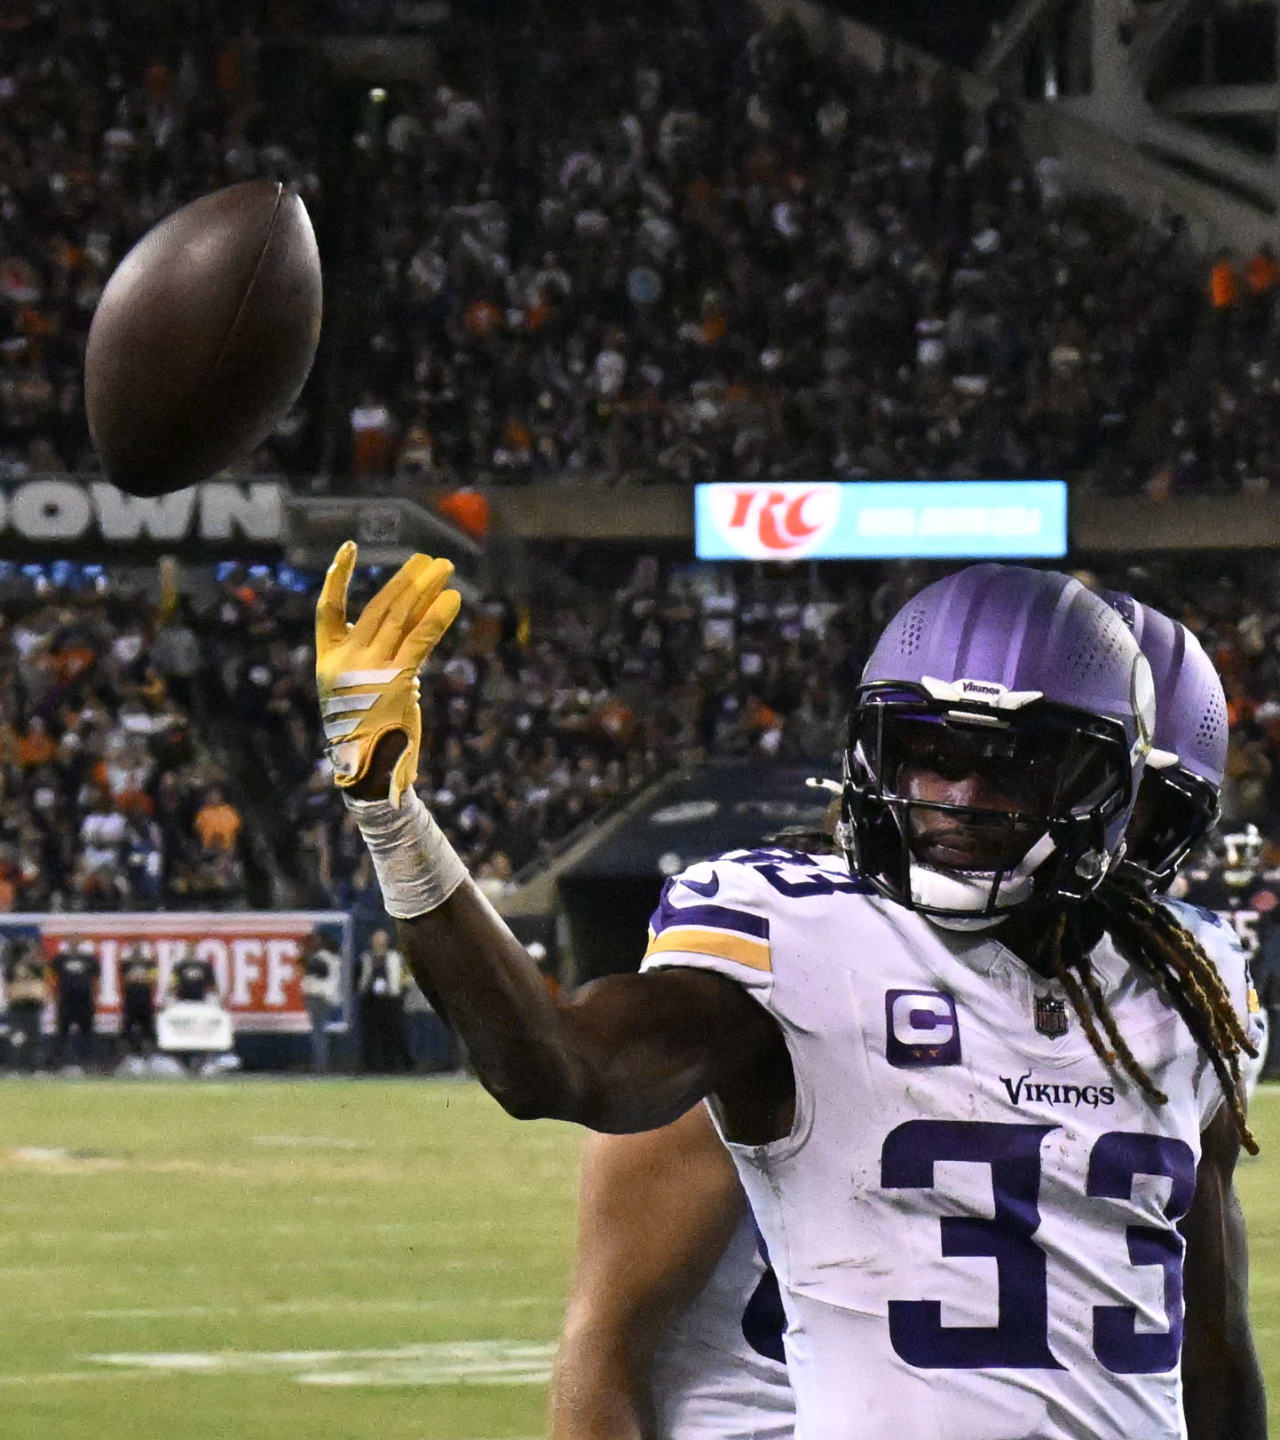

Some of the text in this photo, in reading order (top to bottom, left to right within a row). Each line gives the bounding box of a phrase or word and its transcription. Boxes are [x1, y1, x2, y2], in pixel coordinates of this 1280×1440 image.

[728, 490, 826, 550] RC
[892, 994, 954, 1045] C
[881, 1119, 1197, 1374] 33
